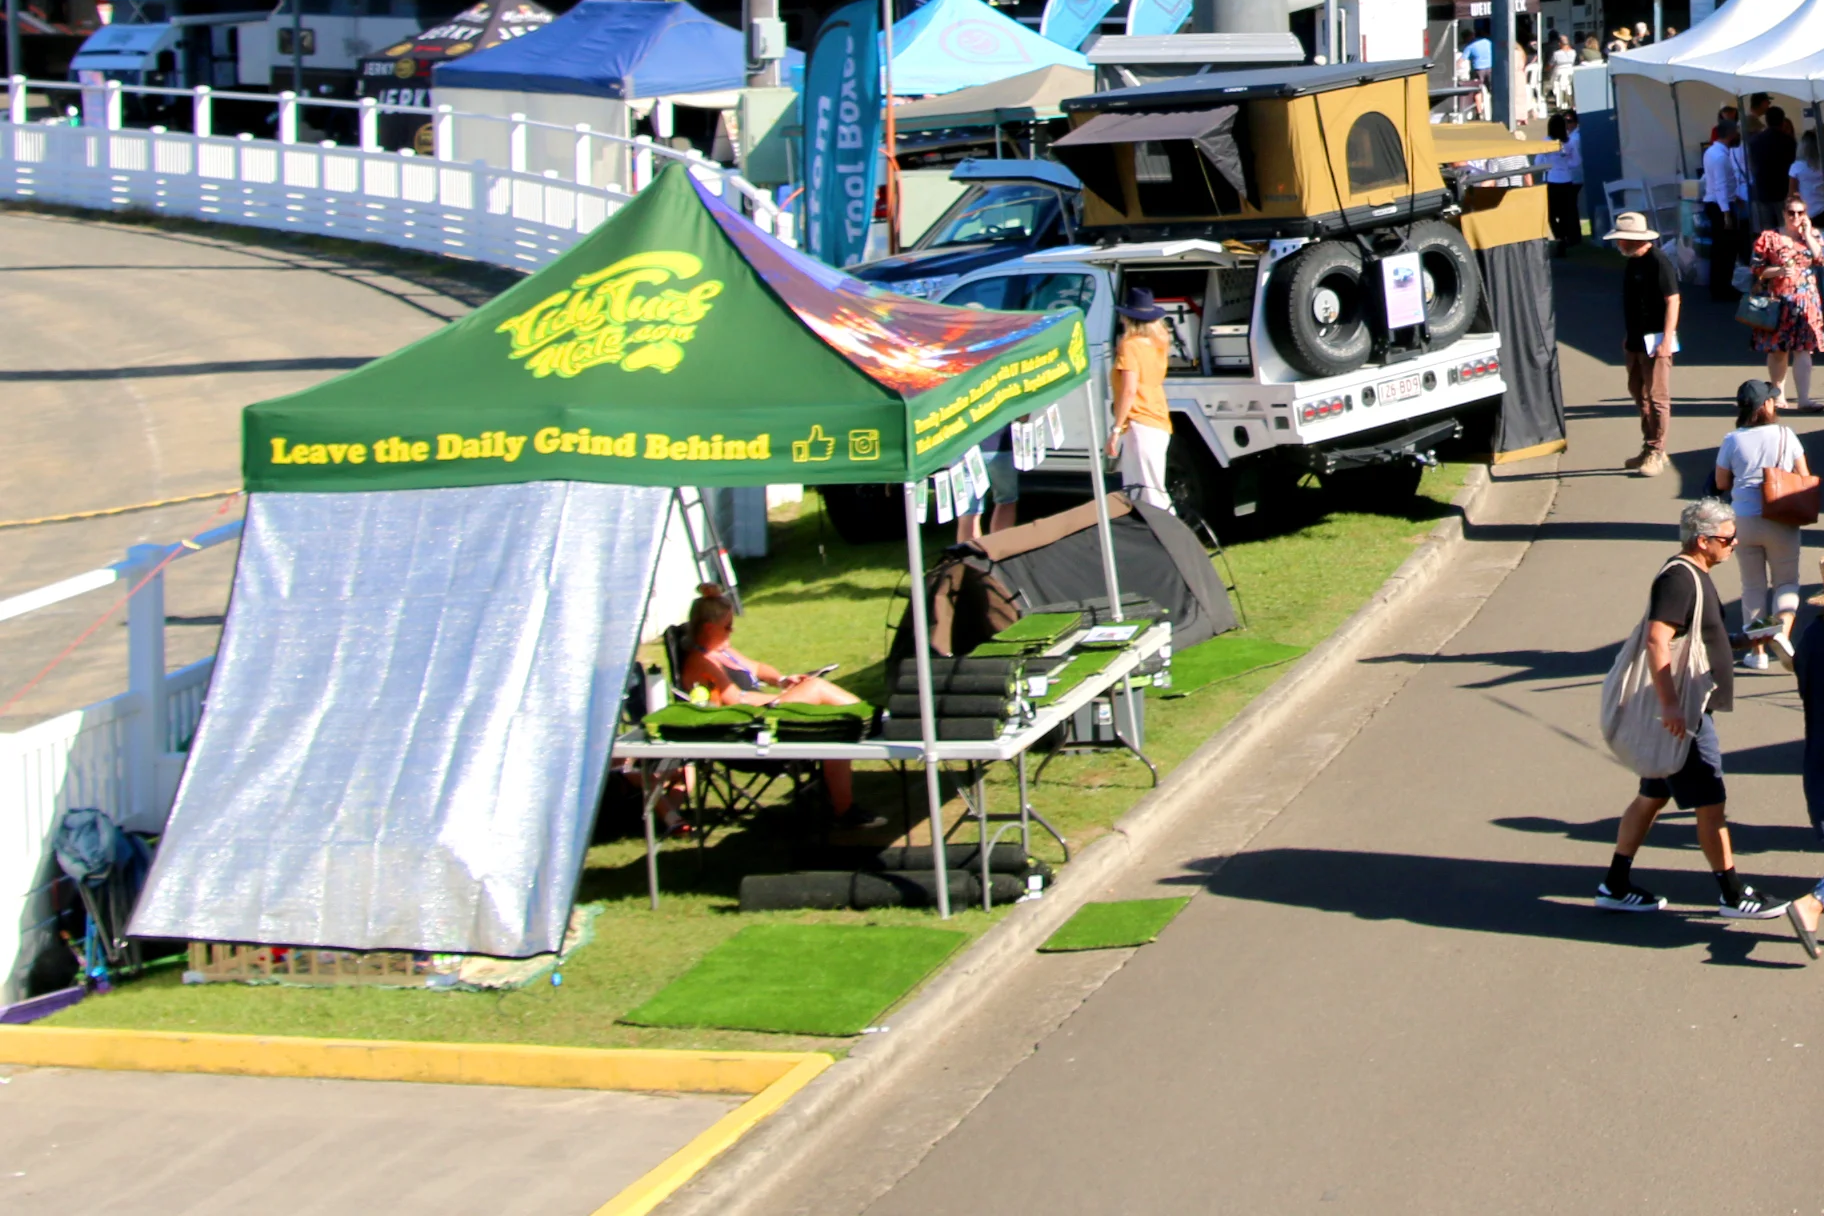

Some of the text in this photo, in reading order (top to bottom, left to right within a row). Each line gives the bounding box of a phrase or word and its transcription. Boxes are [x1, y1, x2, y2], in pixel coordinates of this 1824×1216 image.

[836, 161, 865, 245] Tool
[495, 268, 723, 359] Tidy Turf
[270, 427, 770, 464] Leave the Daily Grind Behind
